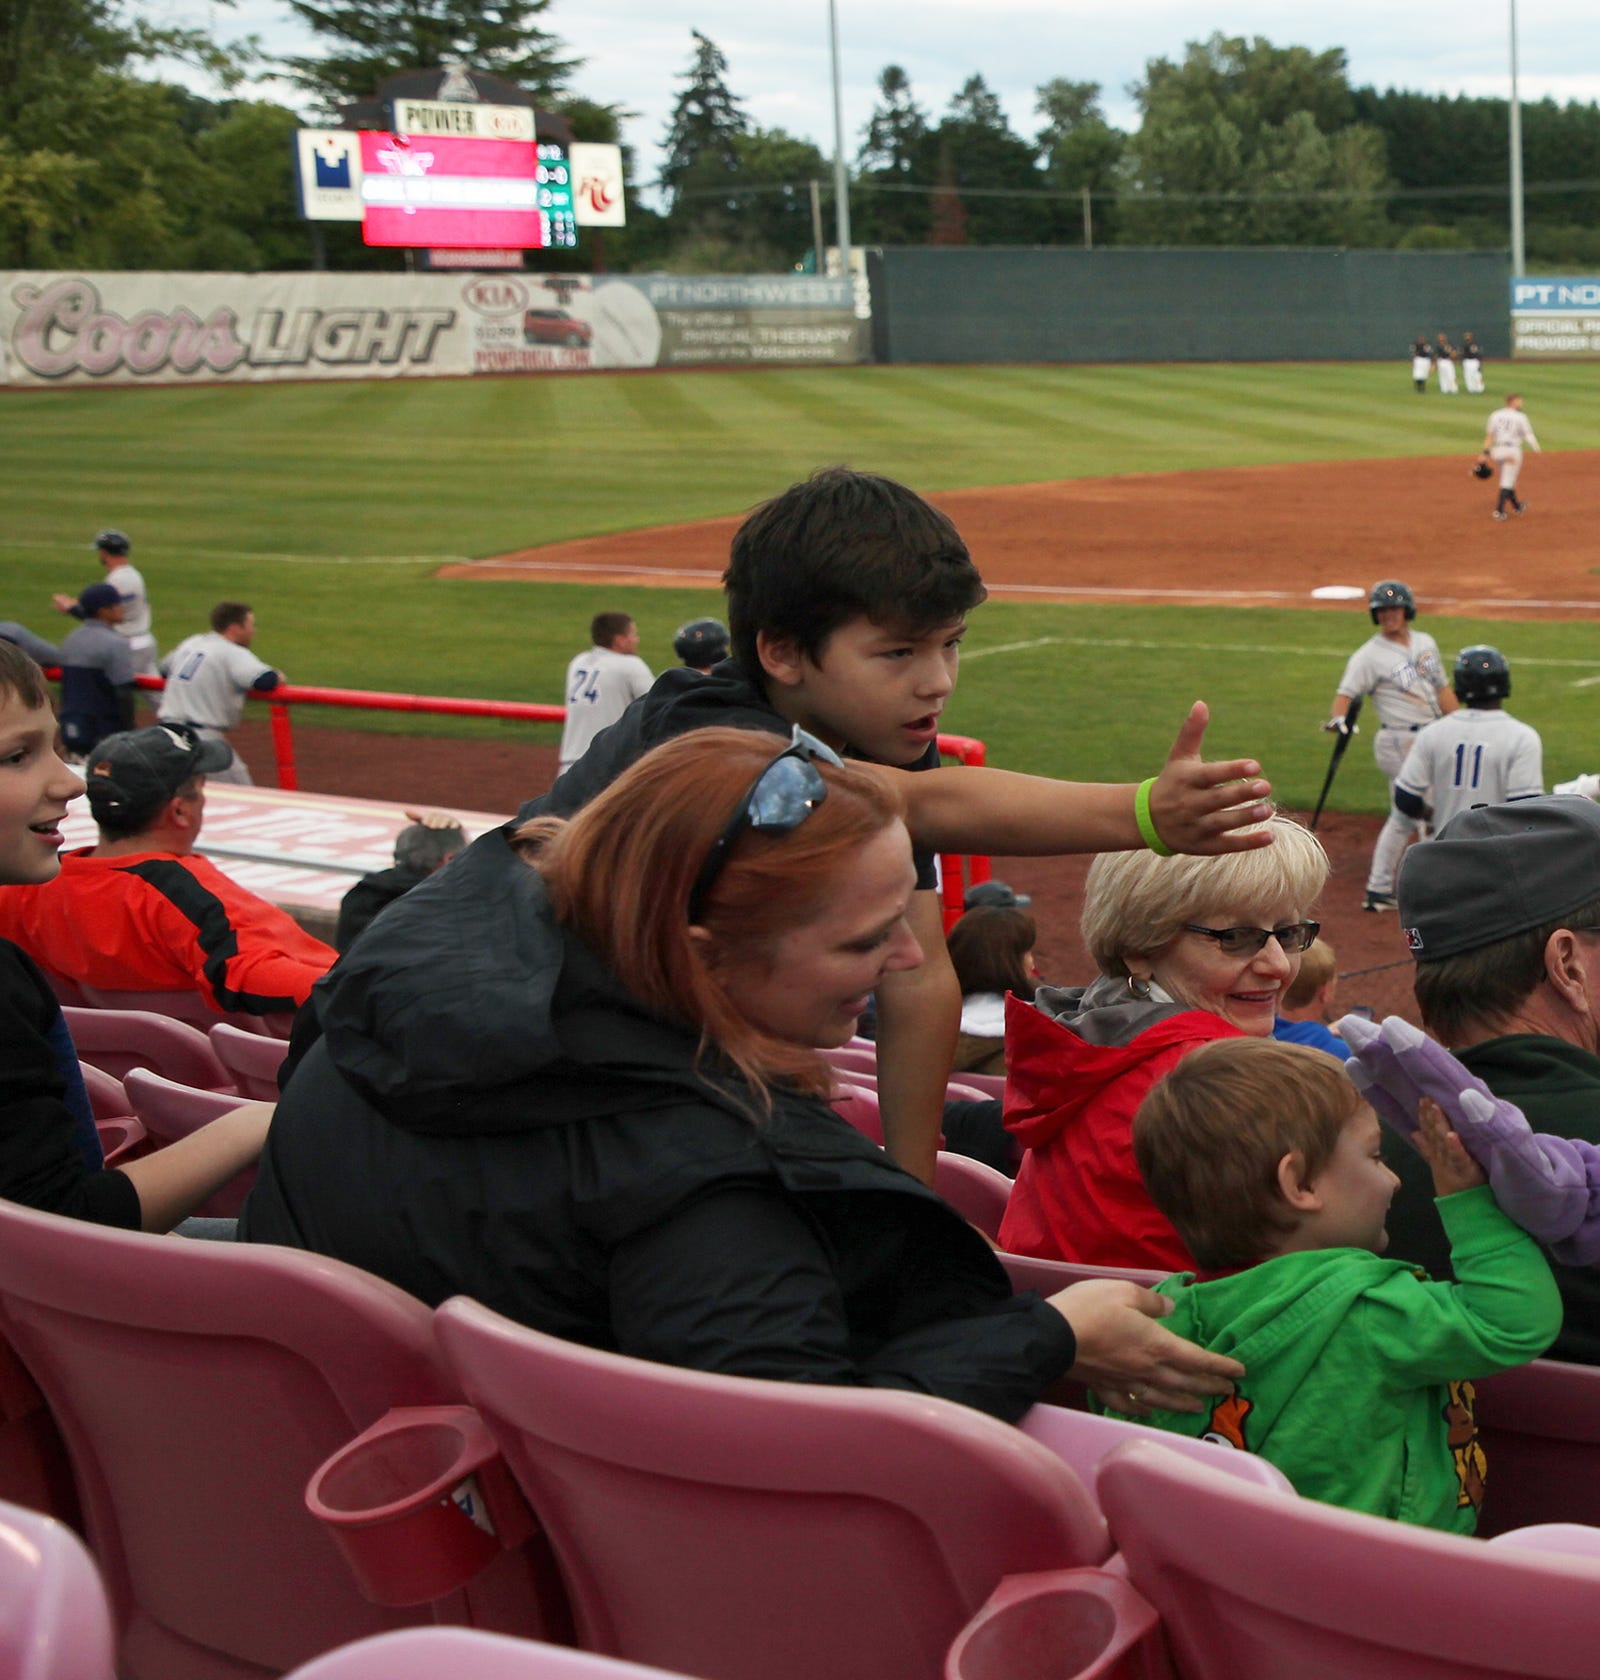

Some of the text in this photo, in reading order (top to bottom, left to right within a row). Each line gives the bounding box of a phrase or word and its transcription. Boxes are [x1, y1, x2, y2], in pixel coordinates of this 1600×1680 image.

[475, 286, 518, 305] KIA
[652, 283, 845, 304] PT NORTHWEST
[1515, 284, 1554, 304] PT
[11, 278, 456, 378] Coors LIGHT
[759, 327, 853, 344] THERAPY
[1517, 319, 1581, 334] OFFICIAL
[1516, 335, 1591, 351] PROVIDER
[568, 669, 601, 705] 24
[1453, 741, 1486, 789] 11
